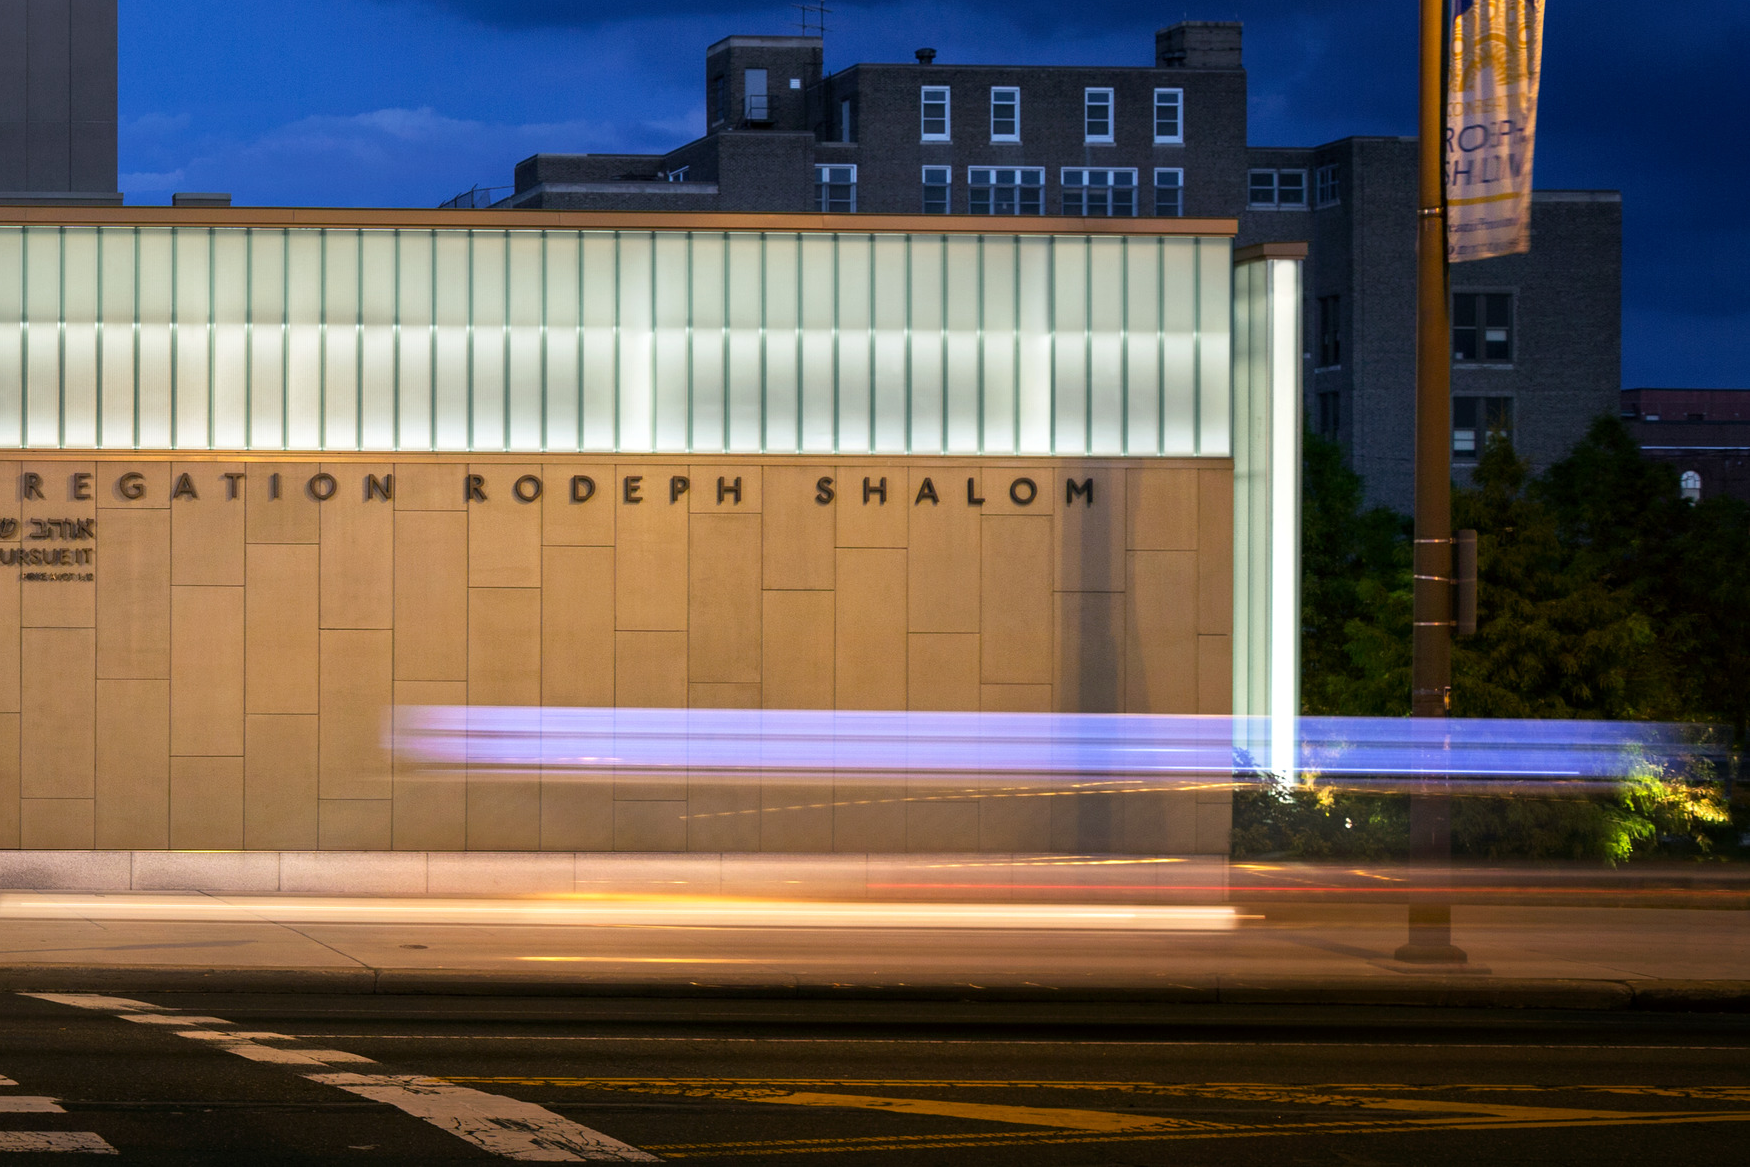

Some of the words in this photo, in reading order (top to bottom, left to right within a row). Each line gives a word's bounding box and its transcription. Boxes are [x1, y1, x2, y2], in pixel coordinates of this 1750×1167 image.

[466, 473, 743, 504] RODEPH
[815, 475, 1094, 505] SHALOM
[29, 517, 95, 539] אוהב
[75, 547, 93, 565] IT
